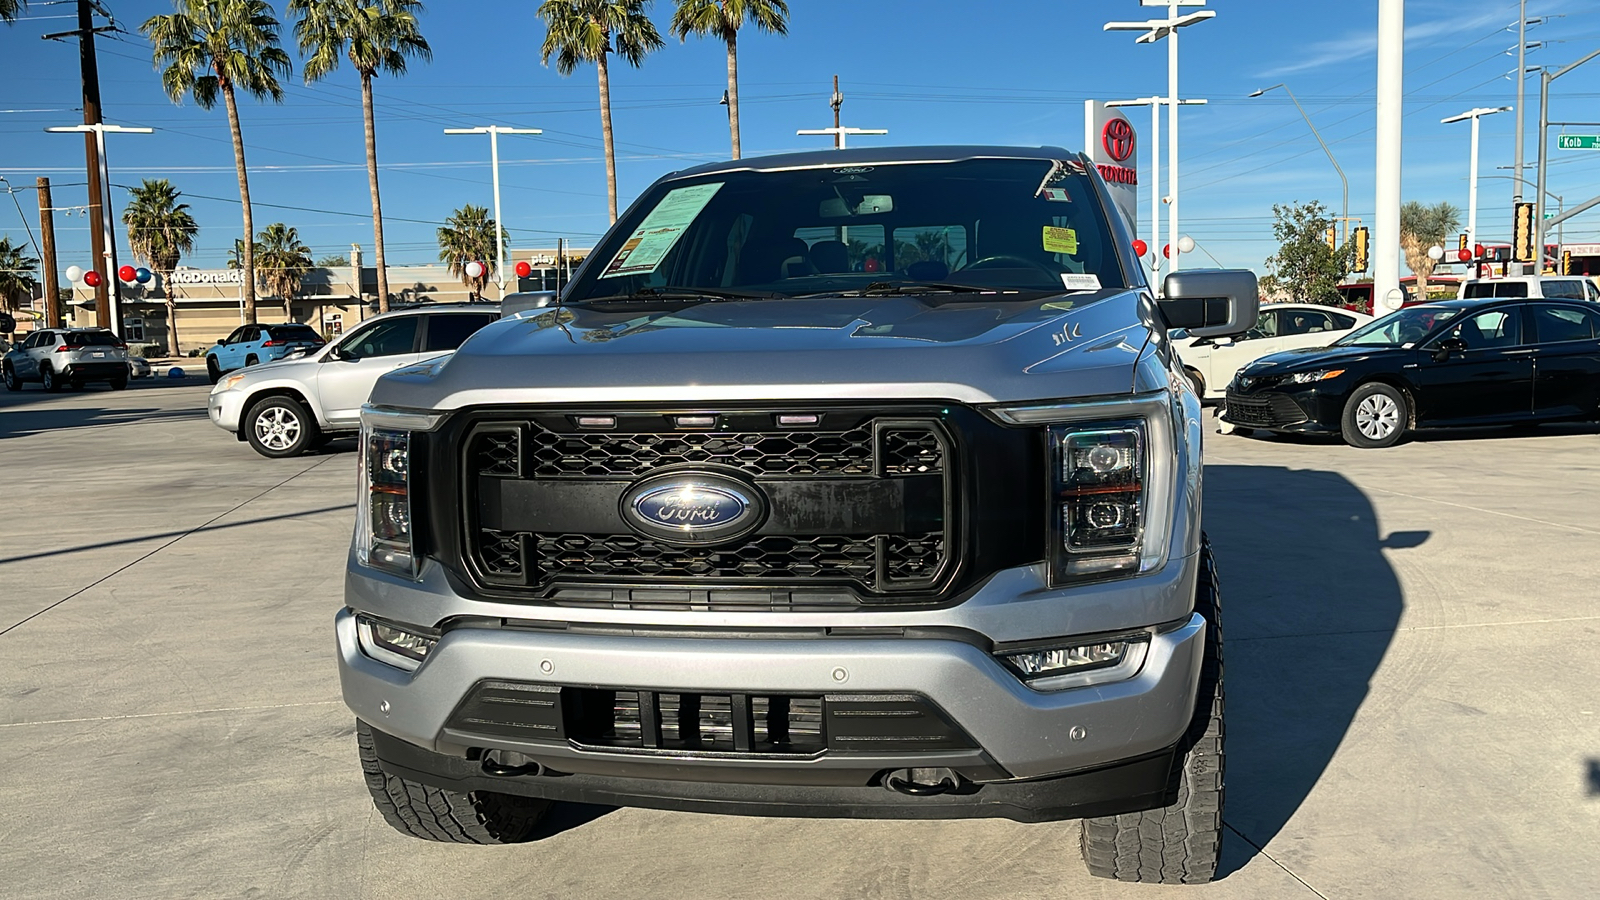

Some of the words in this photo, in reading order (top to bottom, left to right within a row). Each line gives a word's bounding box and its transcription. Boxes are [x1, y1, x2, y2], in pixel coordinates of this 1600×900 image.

[1564, 137, 1582, 147] Kolb
[1096, 164, 1138, 185] TOYOTA
[170, 271, 245, 283] McDonalds
[655, 495, 720, 520] Ford
